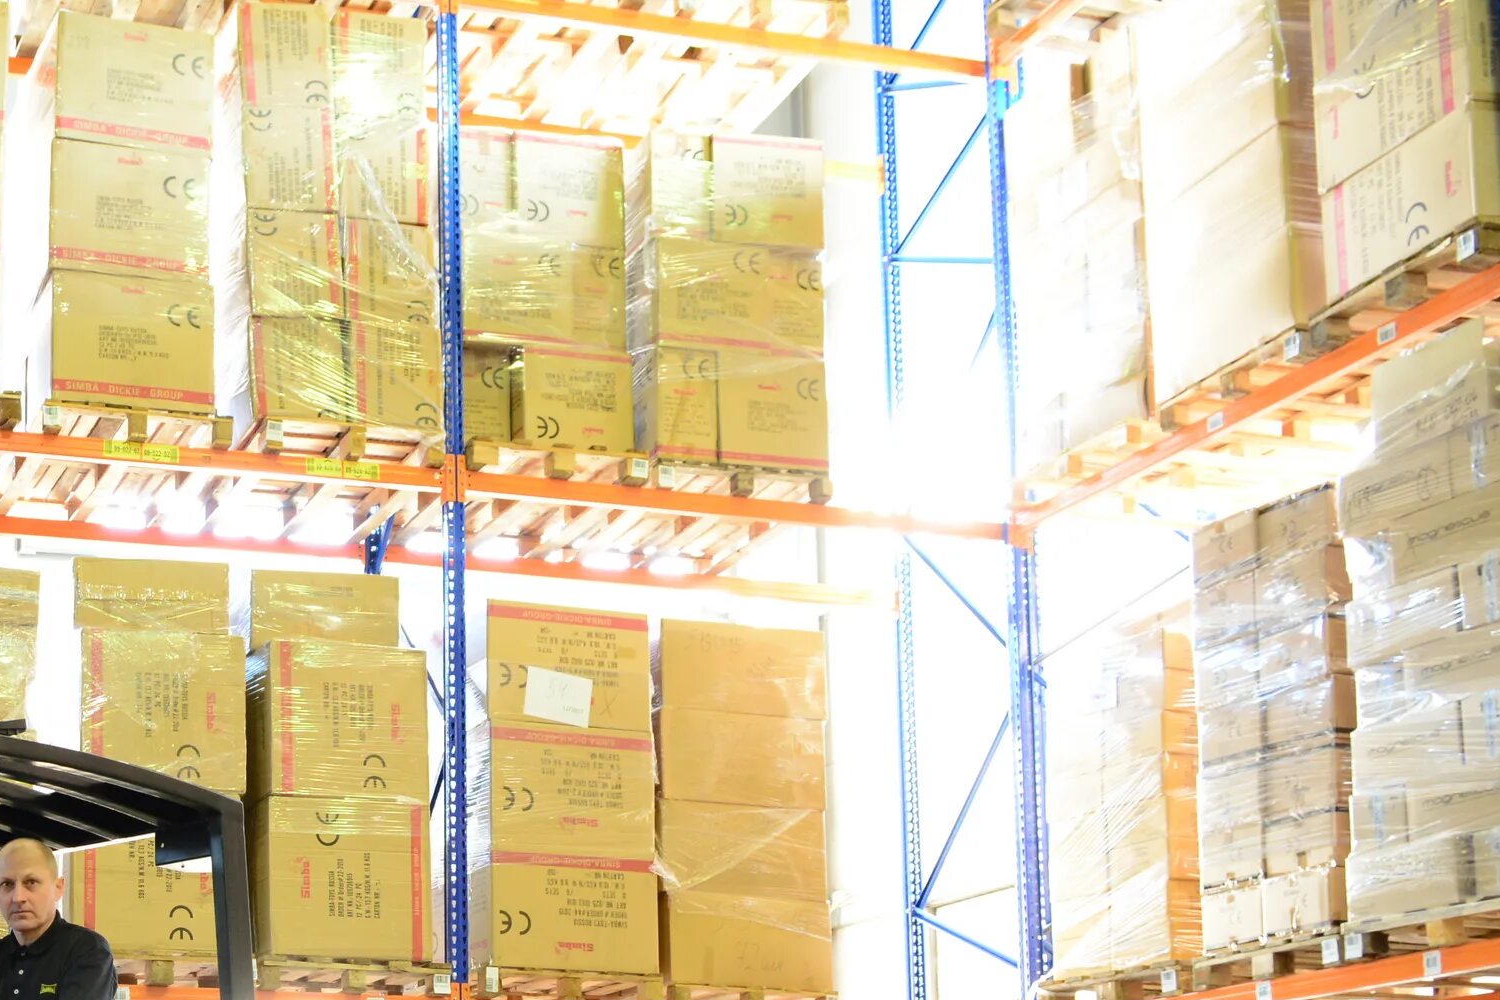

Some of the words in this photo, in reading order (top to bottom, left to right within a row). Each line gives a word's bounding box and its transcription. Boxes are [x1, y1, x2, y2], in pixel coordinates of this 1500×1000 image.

[65, 380, 100, 392] SIMBA
[108, 384, 141, 396] DICKIE
[150, 388, 184, 400] GROUP
[206, 691, 216, 730] Simba
[363, 753, 388, 789] CE
[300, 859, 311, 900] Simba
[603, 872, 625, 881] CARTON
[328, 888, 336, 917] SIMBA-TOYS
[169, 904, 194, 941] CE
[499, 909, 532, 936] CE
[557, 941, 595, 952] Simba
